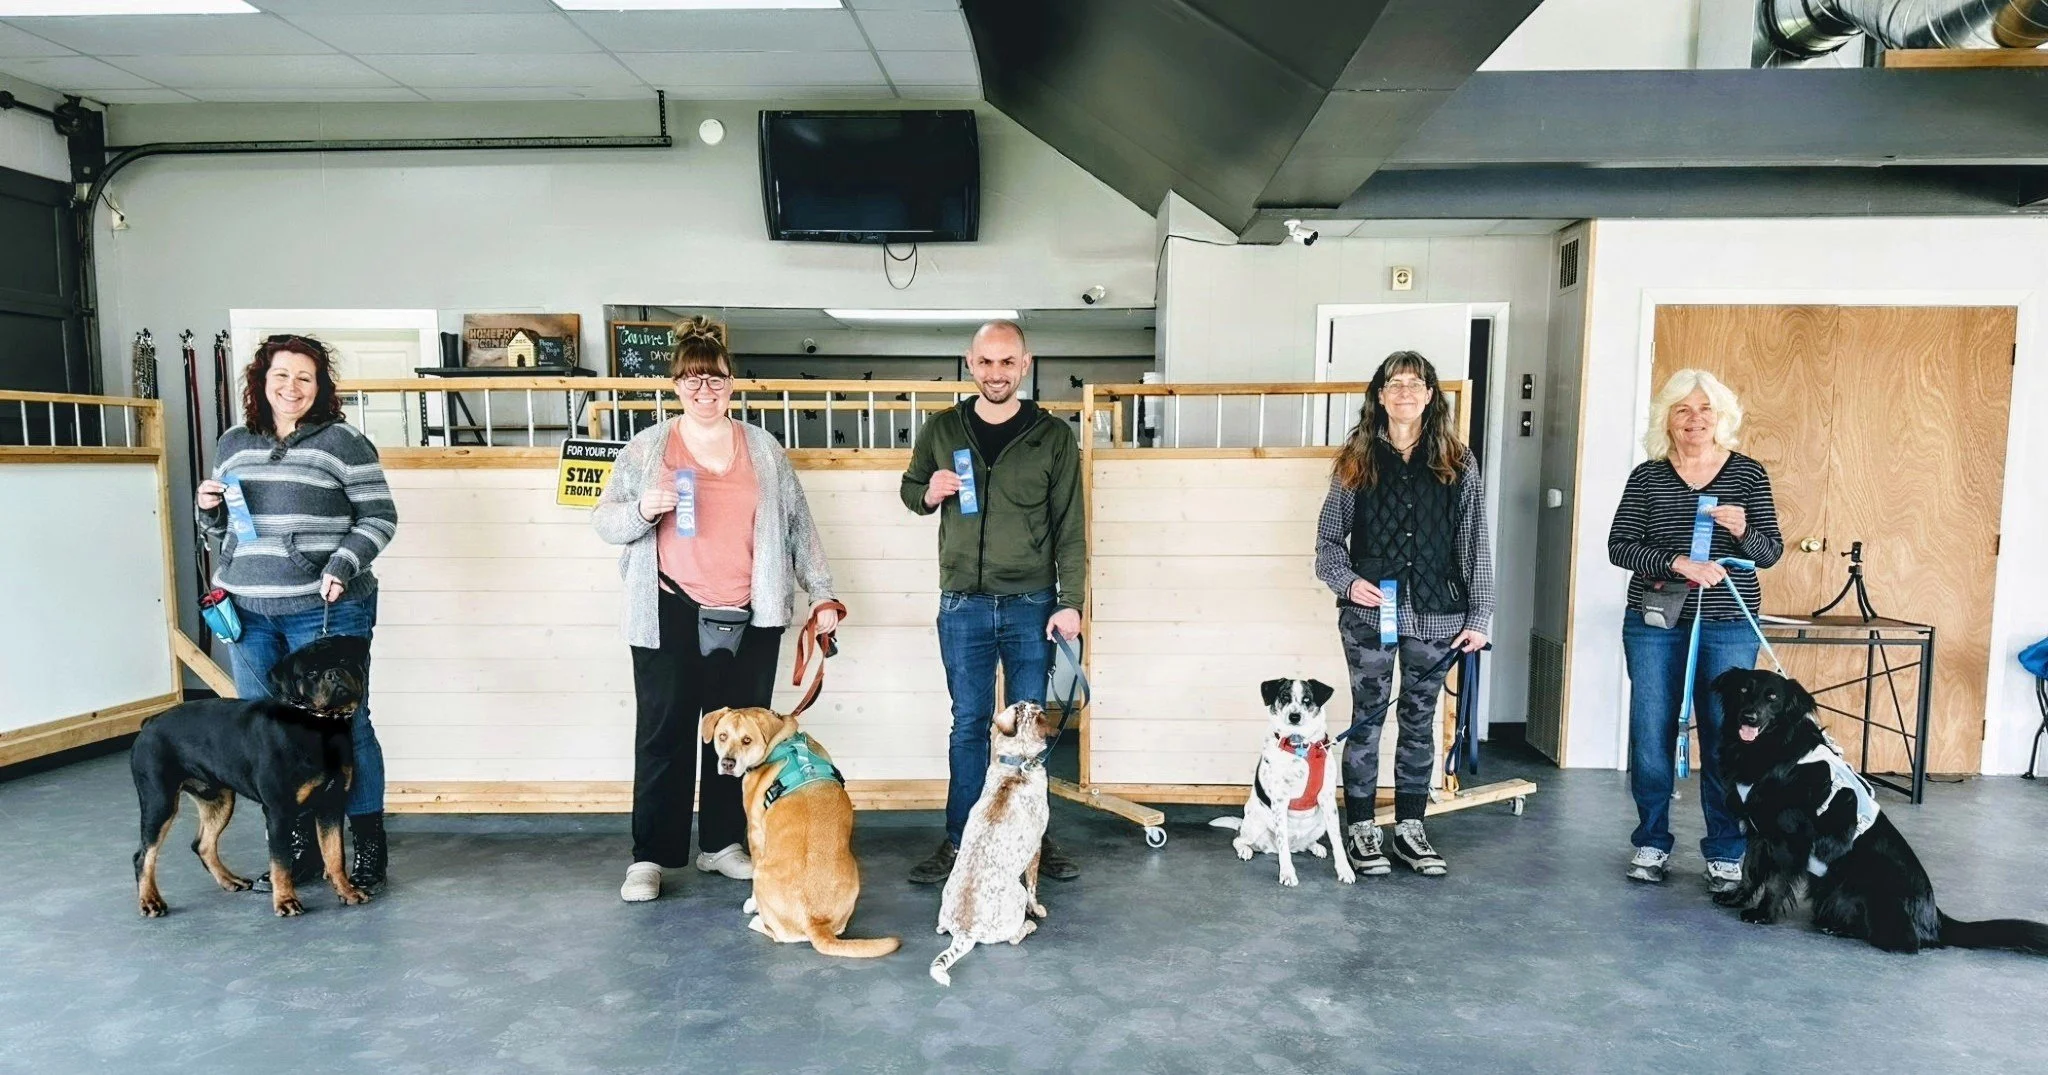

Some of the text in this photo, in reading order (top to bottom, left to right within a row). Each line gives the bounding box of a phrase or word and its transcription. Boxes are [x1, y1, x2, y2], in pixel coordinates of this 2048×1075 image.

[667, 330, 679, 346] B
[650, 350, 675, 361] DAYC
[567, 445, 583, 456] FOR
[585, 446, 606, 457] YOUR
[566, 467, 604, 484] STAY
[565, 485, 603, 497] FROM D
